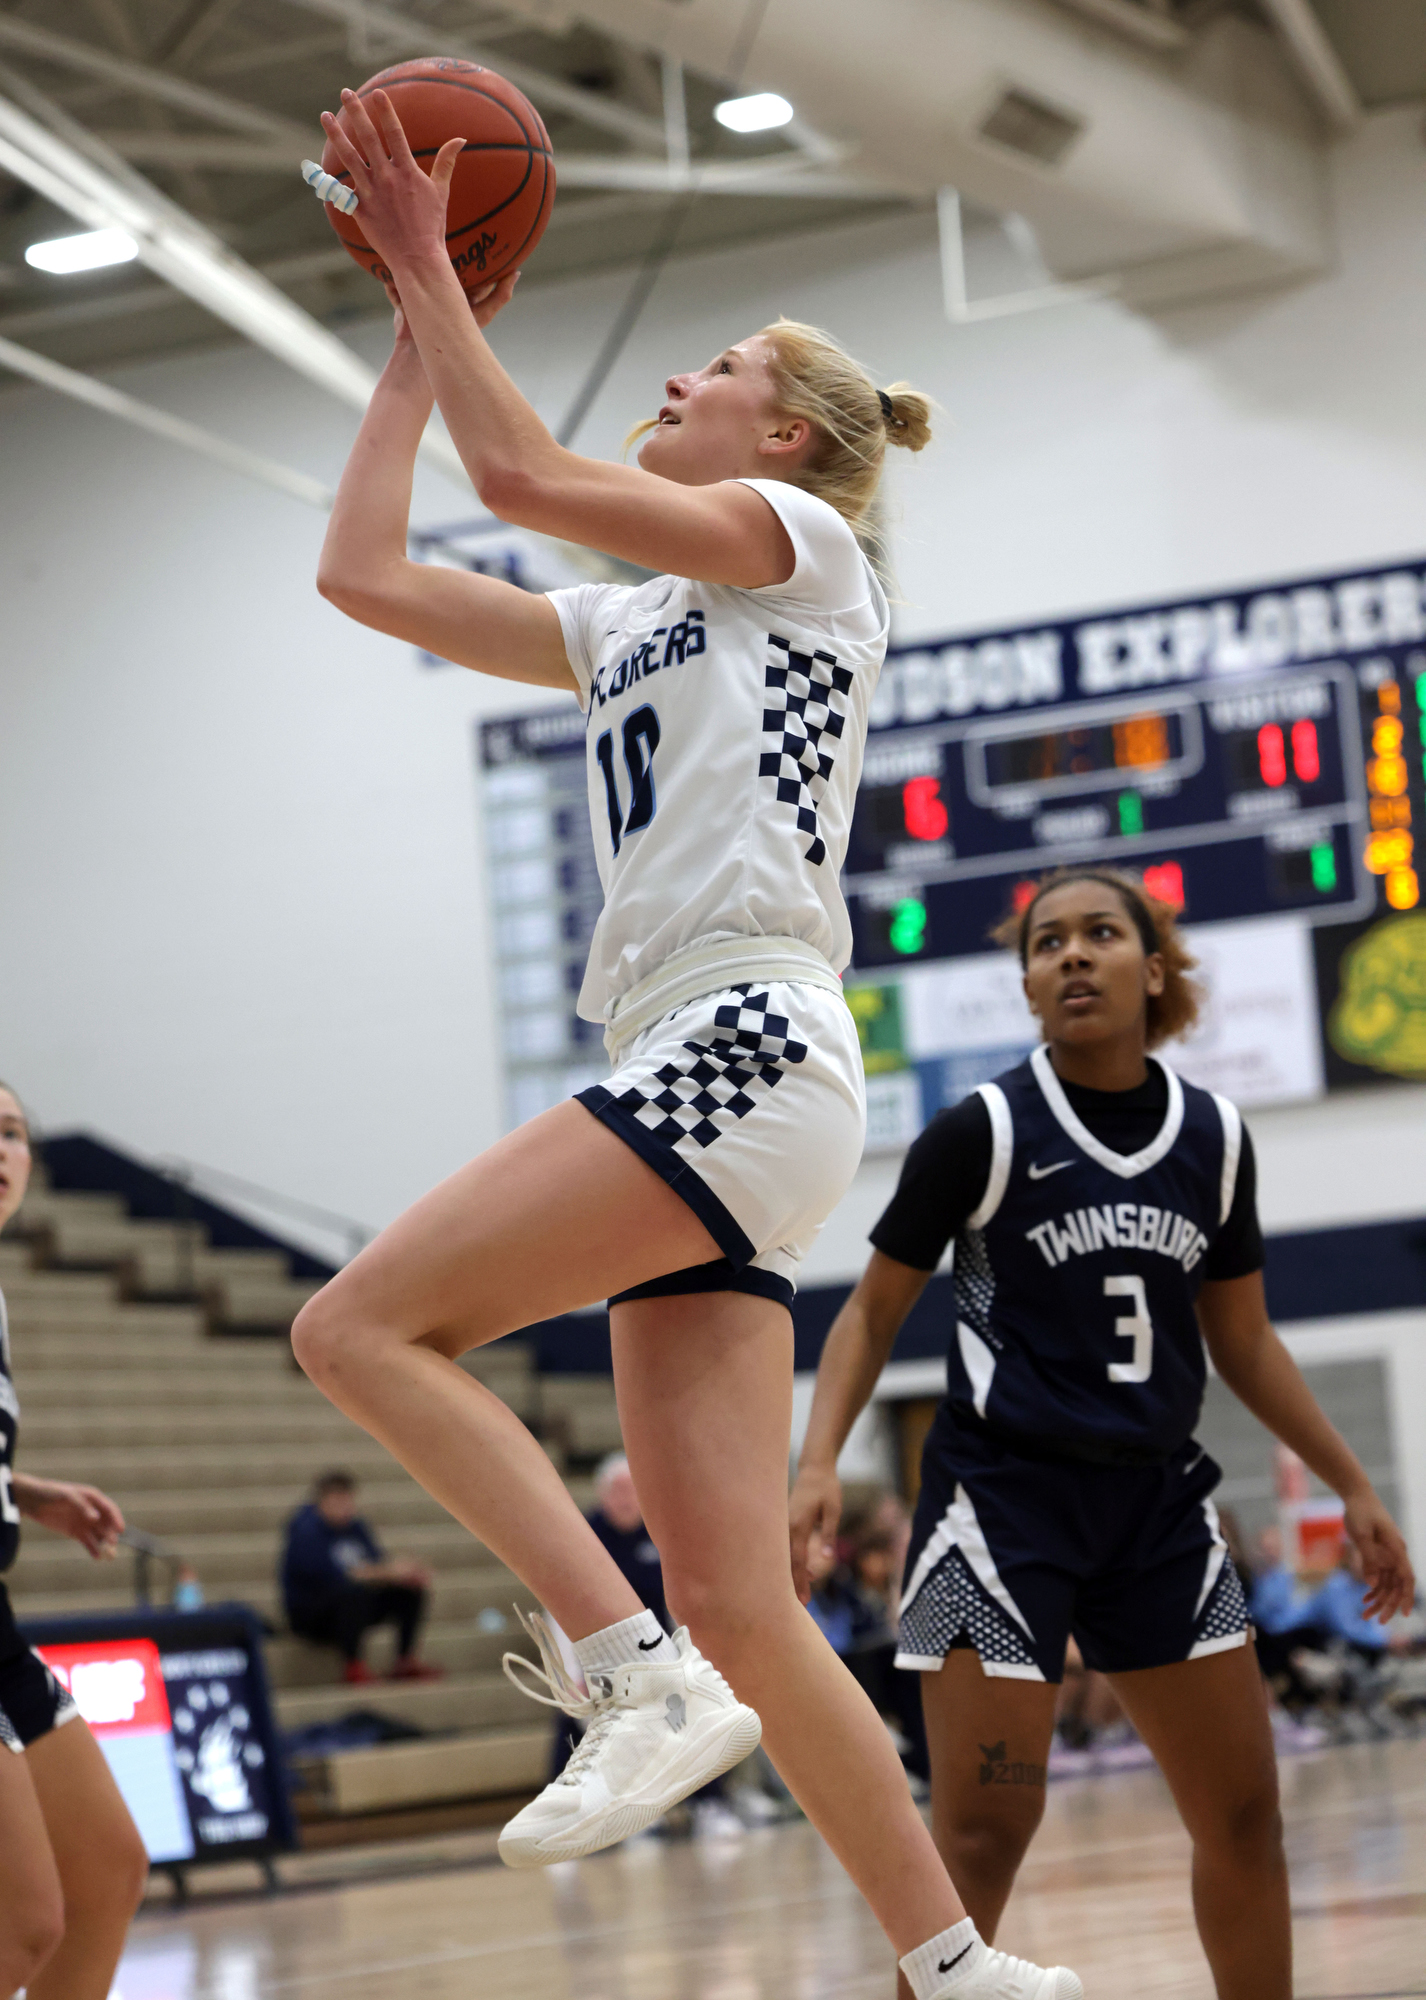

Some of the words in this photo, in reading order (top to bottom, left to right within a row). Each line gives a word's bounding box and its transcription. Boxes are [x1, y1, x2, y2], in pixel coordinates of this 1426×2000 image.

[1076, 573, 1426, 694] EXPLORER
[596, 702, 661, 860] 10
[1258, 723, 1320, 787] 11
[1025, 1203, 1209, 1273] TWINSBURG
[1103, 1274, 1154, 1384] 3
